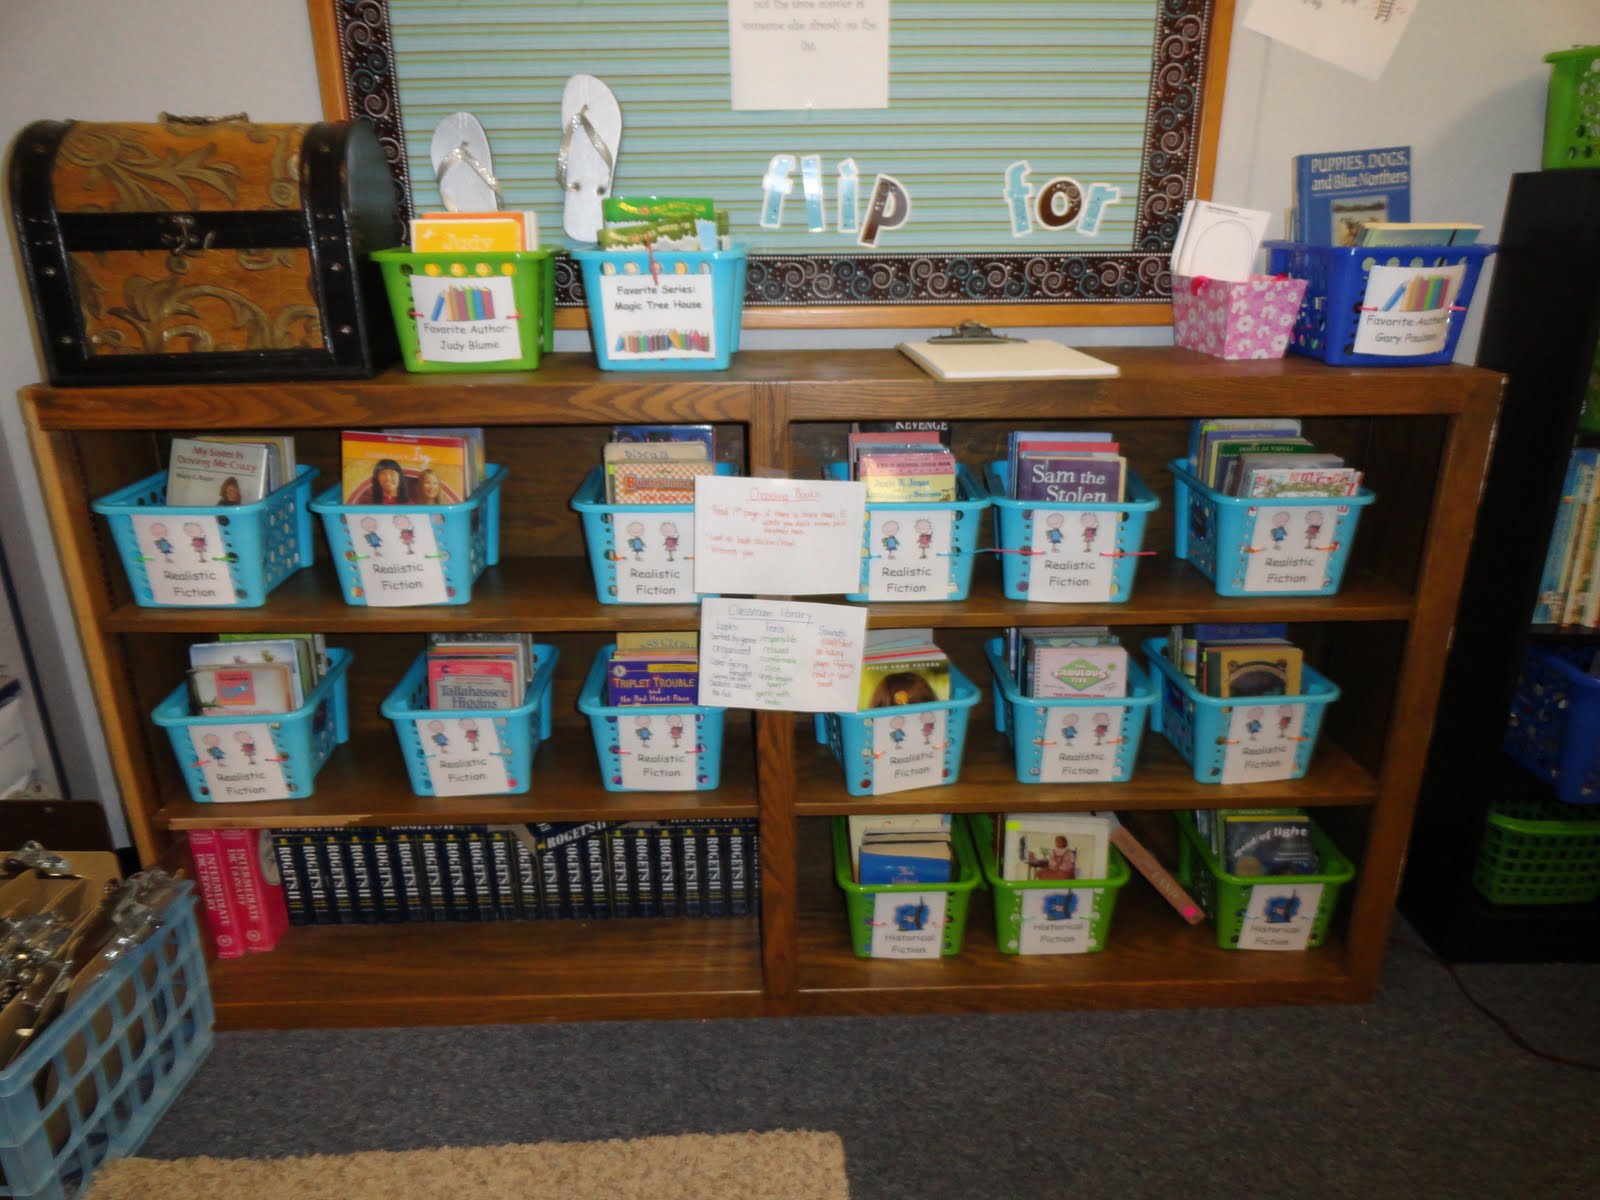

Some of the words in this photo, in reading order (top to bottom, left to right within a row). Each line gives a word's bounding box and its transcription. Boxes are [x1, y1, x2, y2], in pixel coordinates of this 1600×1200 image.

[1311, 174, 1332, 191] and
[1333, 173, 1357, 188] Blue
[760, 154, 911, 248] flip
[1004, 160, 1120, 237] for
[442, 233, 495, 251] Judy
[616, 285, 657, 295] Favorite
[662, 285, 696, 294] Series:
[614, 301, 643, 312] Magic
[647, 300, 669, 309] Tree
[673, 301, 702, 309] House
[1365, 314, 1414, 327] Favorite
[423, 322, 467, 334] Favorite
[1374, 332, 1401, 345] Gary
[440, 339, 465, 352] Judy
[468, 339, 500, 350] Blume
[1032, 464, 1075, 484] Sam
[1080, 472, 1106, 485] the
[1046, 485, 1106, 502] Stolen
[1044, 559, 1096, 570] Realistic
[1264, 557, 1315, 567] Realistic
[372, 563, 424, 573] Realistic
[881, 566, 932, 576] Realistic
[163, 571, 216, 580] Realistic
[629, 568, 680, 579] Realistic
[1266, 574, 1307, 583] Fiction
[381, 580, 423, 591] Fiction
[1049, 576, 1089, 586] Fiction
[172, 587, 216, 597] Fiction
[636, 585, 676, 595] Fiction
[886, 583, 926, 593] Fiction
[1053, 668, 1109, 680] FABULOUS
[613, 677, 651, 688] TRIPLET
[653, 676, 696, 688] TROUBLE
[441, 685, 509, 698] Tallahassee
[452, 697, 498, 709] Higgins
[650, 694, 670, 702] Heart
[637, 754, 685, 763] Realistic
[889, 752, 935, 765] Realistic
[1059, 752, 1106, 761] Realistic
[439, 758, 487, 768] Realistic
[1244, 759, 1280, 769] Fiction
[643, 768, 681, 777] Fiction
[894, 767, 931, 778] Fiction
[1061, 767, 1099, 775] Fiction
[216, 772, 267, 782] Realistic
[448, 773, 486, 782] Fiction
[226, 786, 267, 795] Fiction
[1274, 826, 1308, 839] light
[206, 854, 230, 925] INTERMEDIATE
[884, 933, 935, 942] Historical
[1040, 935, 1075, 944] Fiction
[891, 945, 927, 954] Fiction
